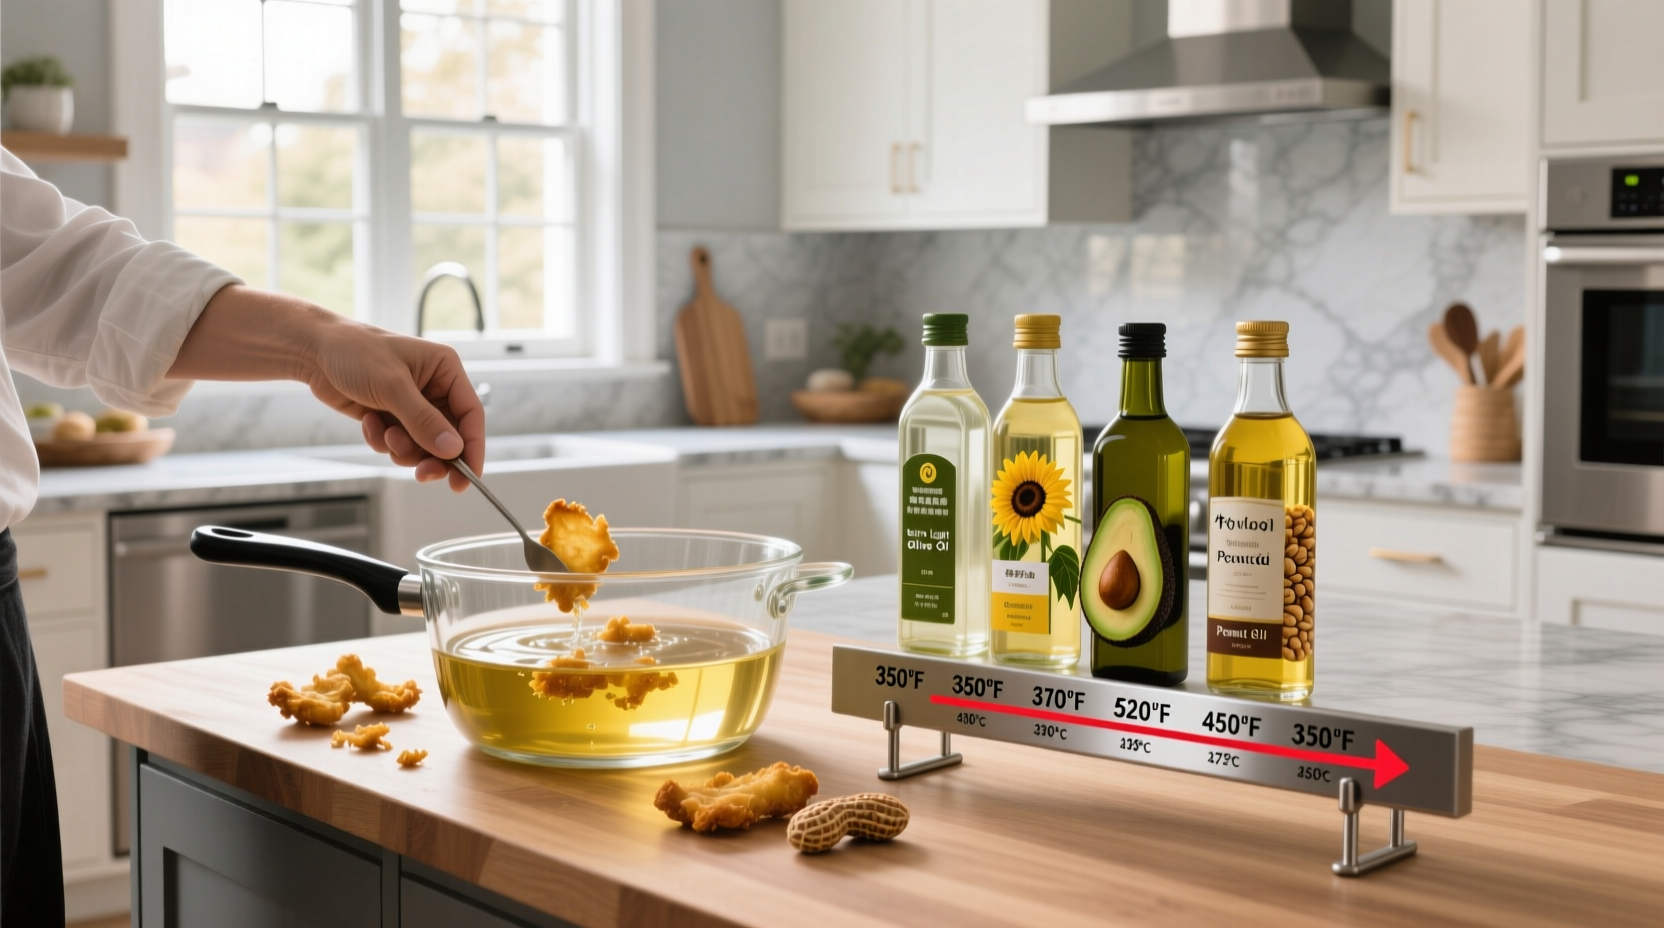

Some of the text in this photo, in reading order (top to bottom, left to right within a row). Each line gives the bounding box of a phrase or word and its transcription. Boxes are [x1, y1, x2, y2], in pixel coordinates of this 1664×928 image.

[875, 665, 925, 689] 350°F
[952, 675, 1004, 699] 350°F
[1031, 686, 1086, 710] 370°F
[1113, 697, 1171, 723] 520°F
[1202, 711, 1262, 737] 450°F
[1291, 723, 1355, 751] 350°F
